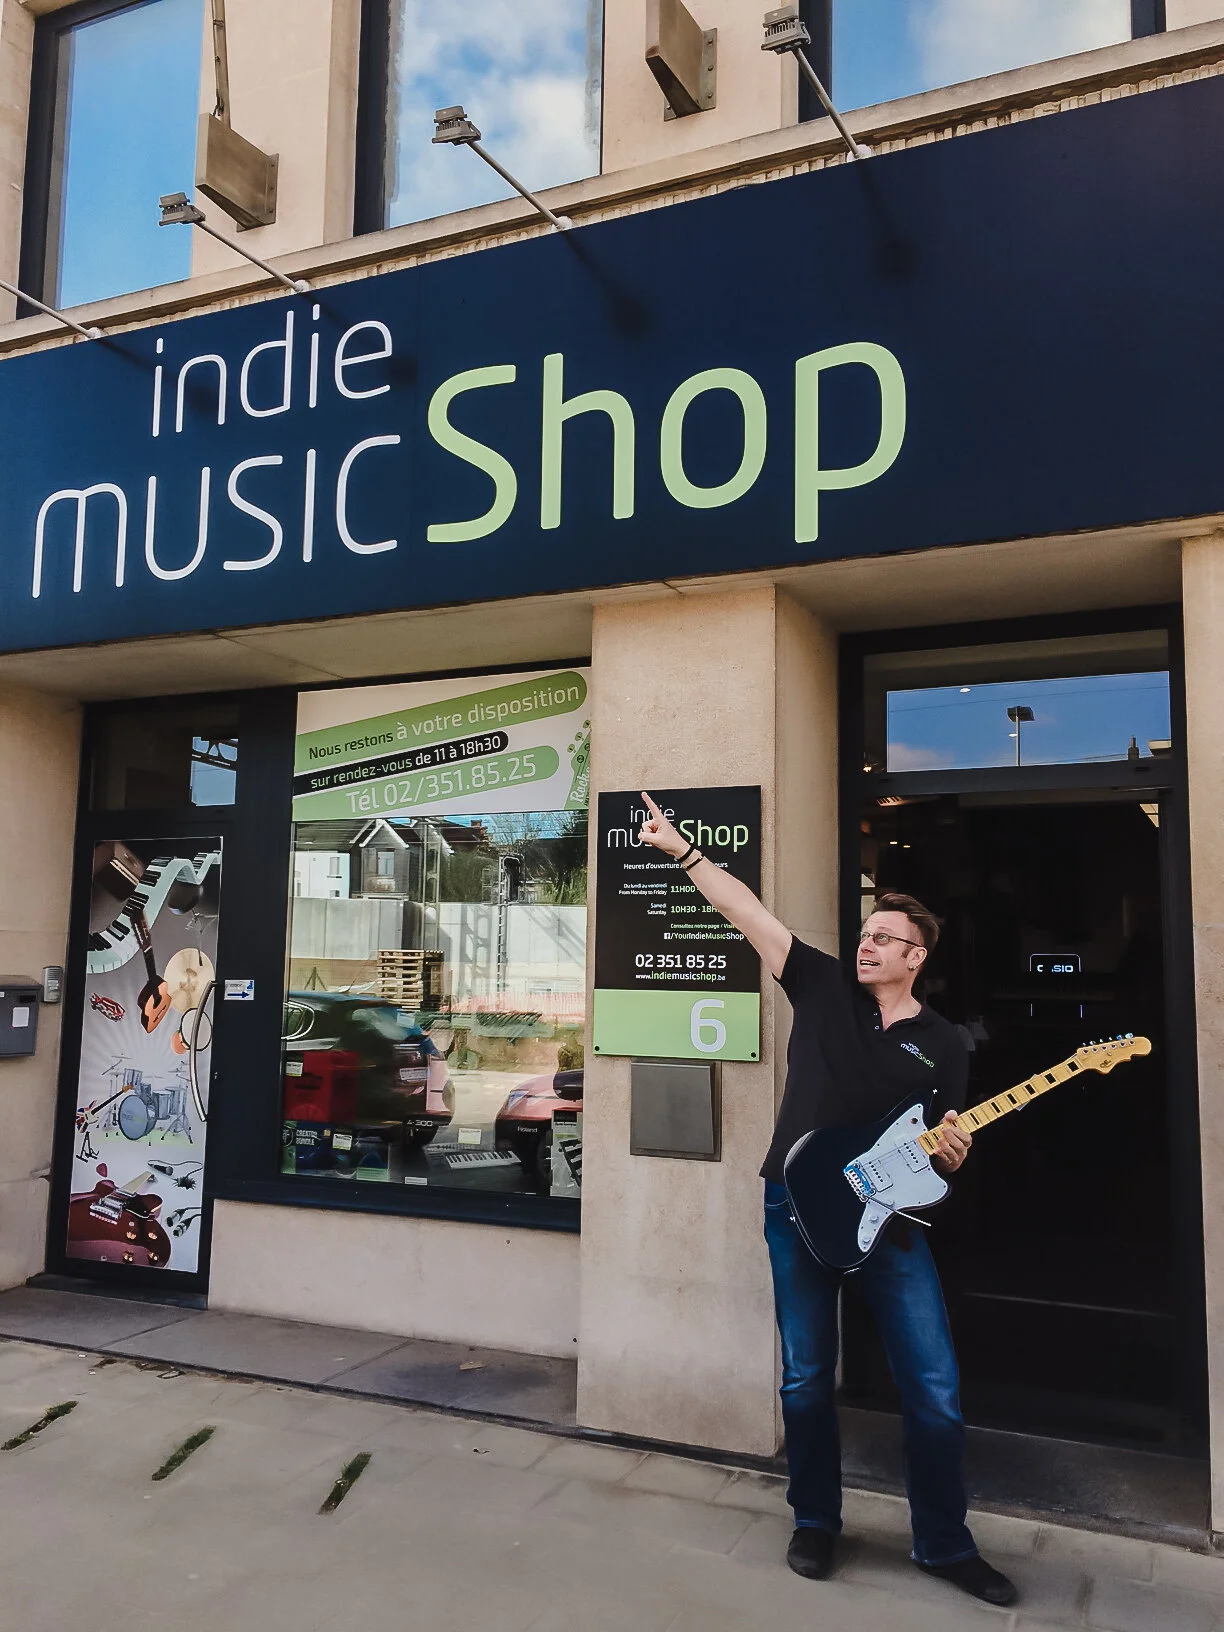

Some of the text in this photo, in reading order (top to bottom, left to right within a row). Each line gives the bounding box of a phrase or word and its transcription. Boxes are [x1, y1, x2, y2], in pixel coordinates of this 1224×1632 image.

[152, 303, 394, 437] indie
[426, 341, 907, 543] Shop
[309, 684, 581, 760] Nous restons à votre disposition
[310, 734, 502, 789] sur rendez-vous de 11 à 18h30
[345, 787, 380, 814] Tél
[383, 753, 538, 808] 02/351.85.25
[679, 819, 749, 853] Shop
[645, 862, 680, 870] d'ouverture
[670, 885, 696, 893] 11H00
[670, 905, 697, 913] 10H30
[702, 905, 720, 913] 18H
[635, 953, 727, 969] 02 351 85 25
[635, 971, 726, 983] www.indiemusicshop.be
[690, 998, 727, 1054] 6
